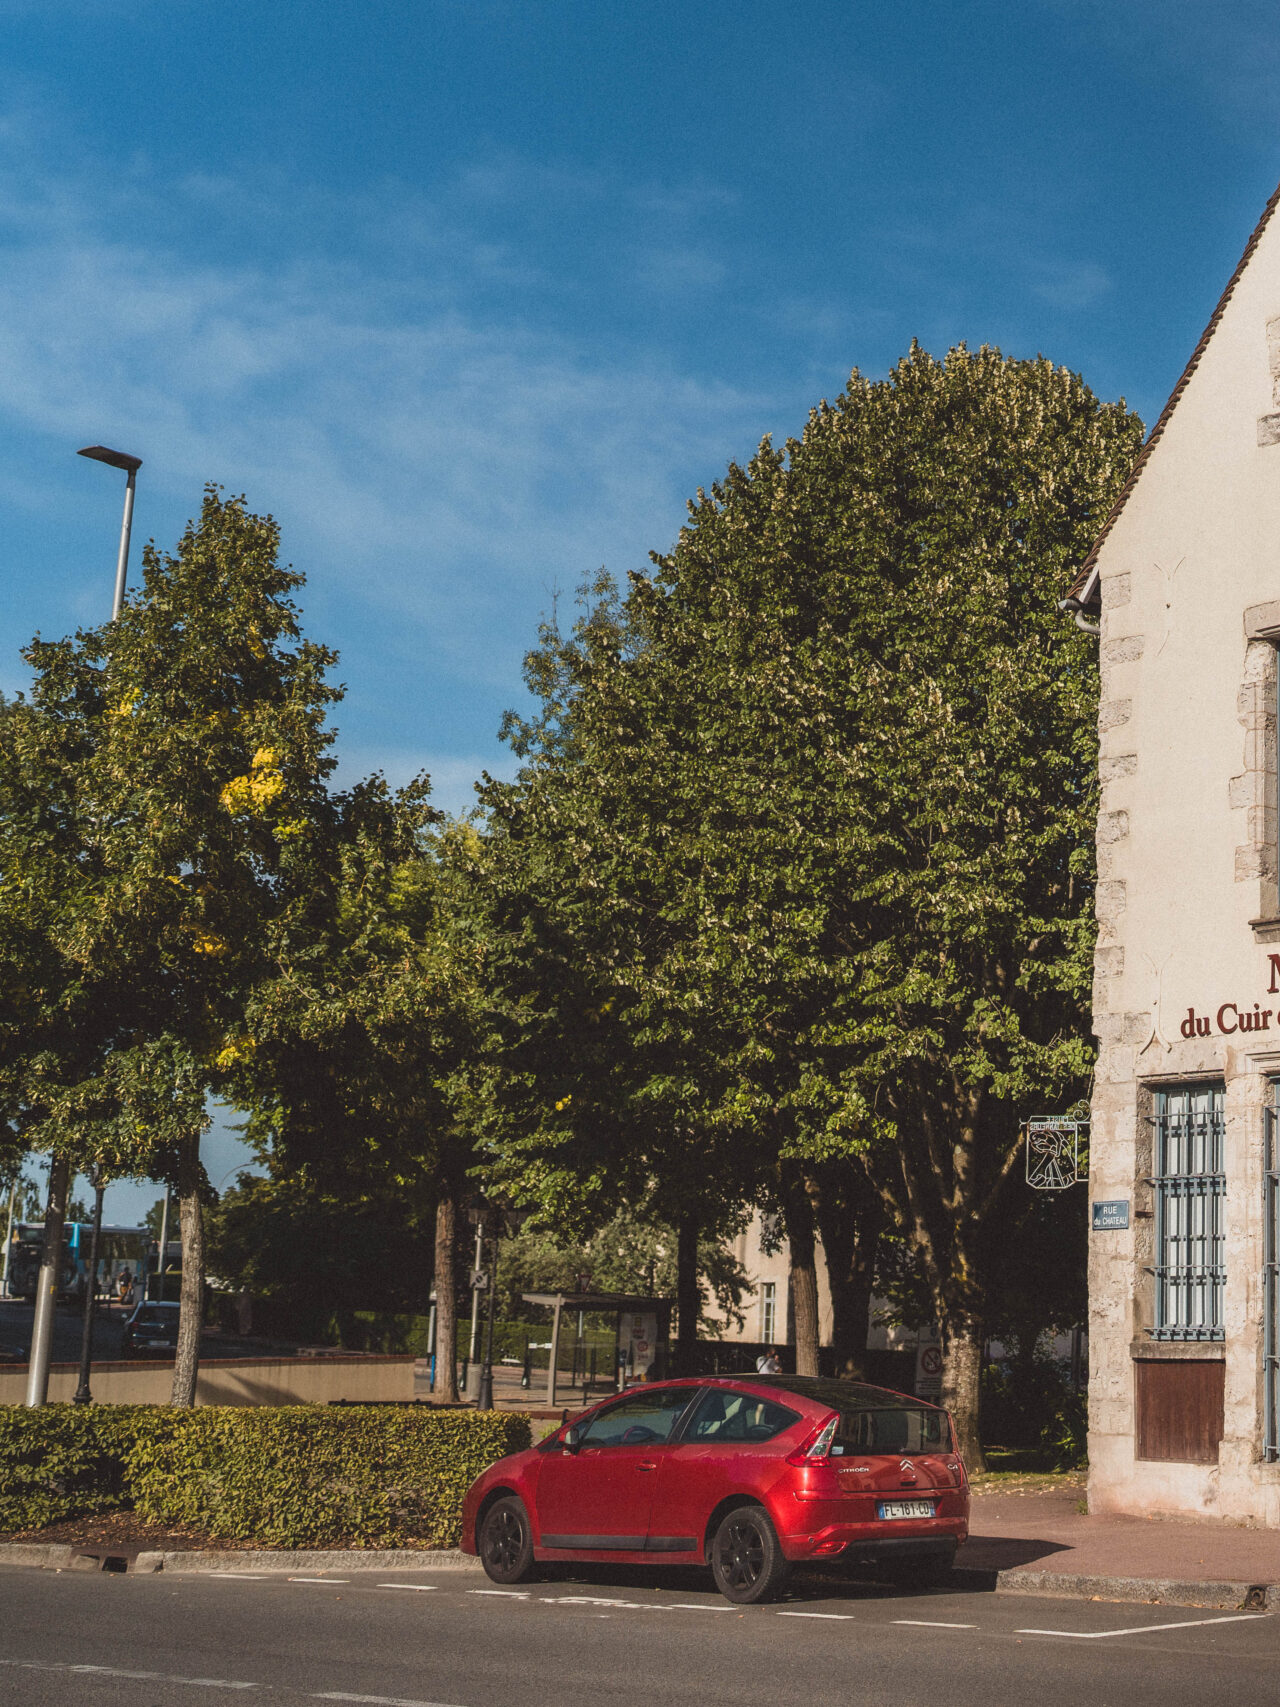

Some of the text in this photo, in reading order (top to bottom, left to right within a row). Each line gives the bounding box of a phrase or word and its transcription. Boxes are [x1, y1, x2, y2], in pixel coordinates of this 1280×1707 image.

[1180, 1008, 1211, 1038] du
[1216, 1003, 1272, 1034] Cuir
[1103, 1205, 1118, 1214] RUE
[1094, 1216, 1127, 1225] du CHATEAU
